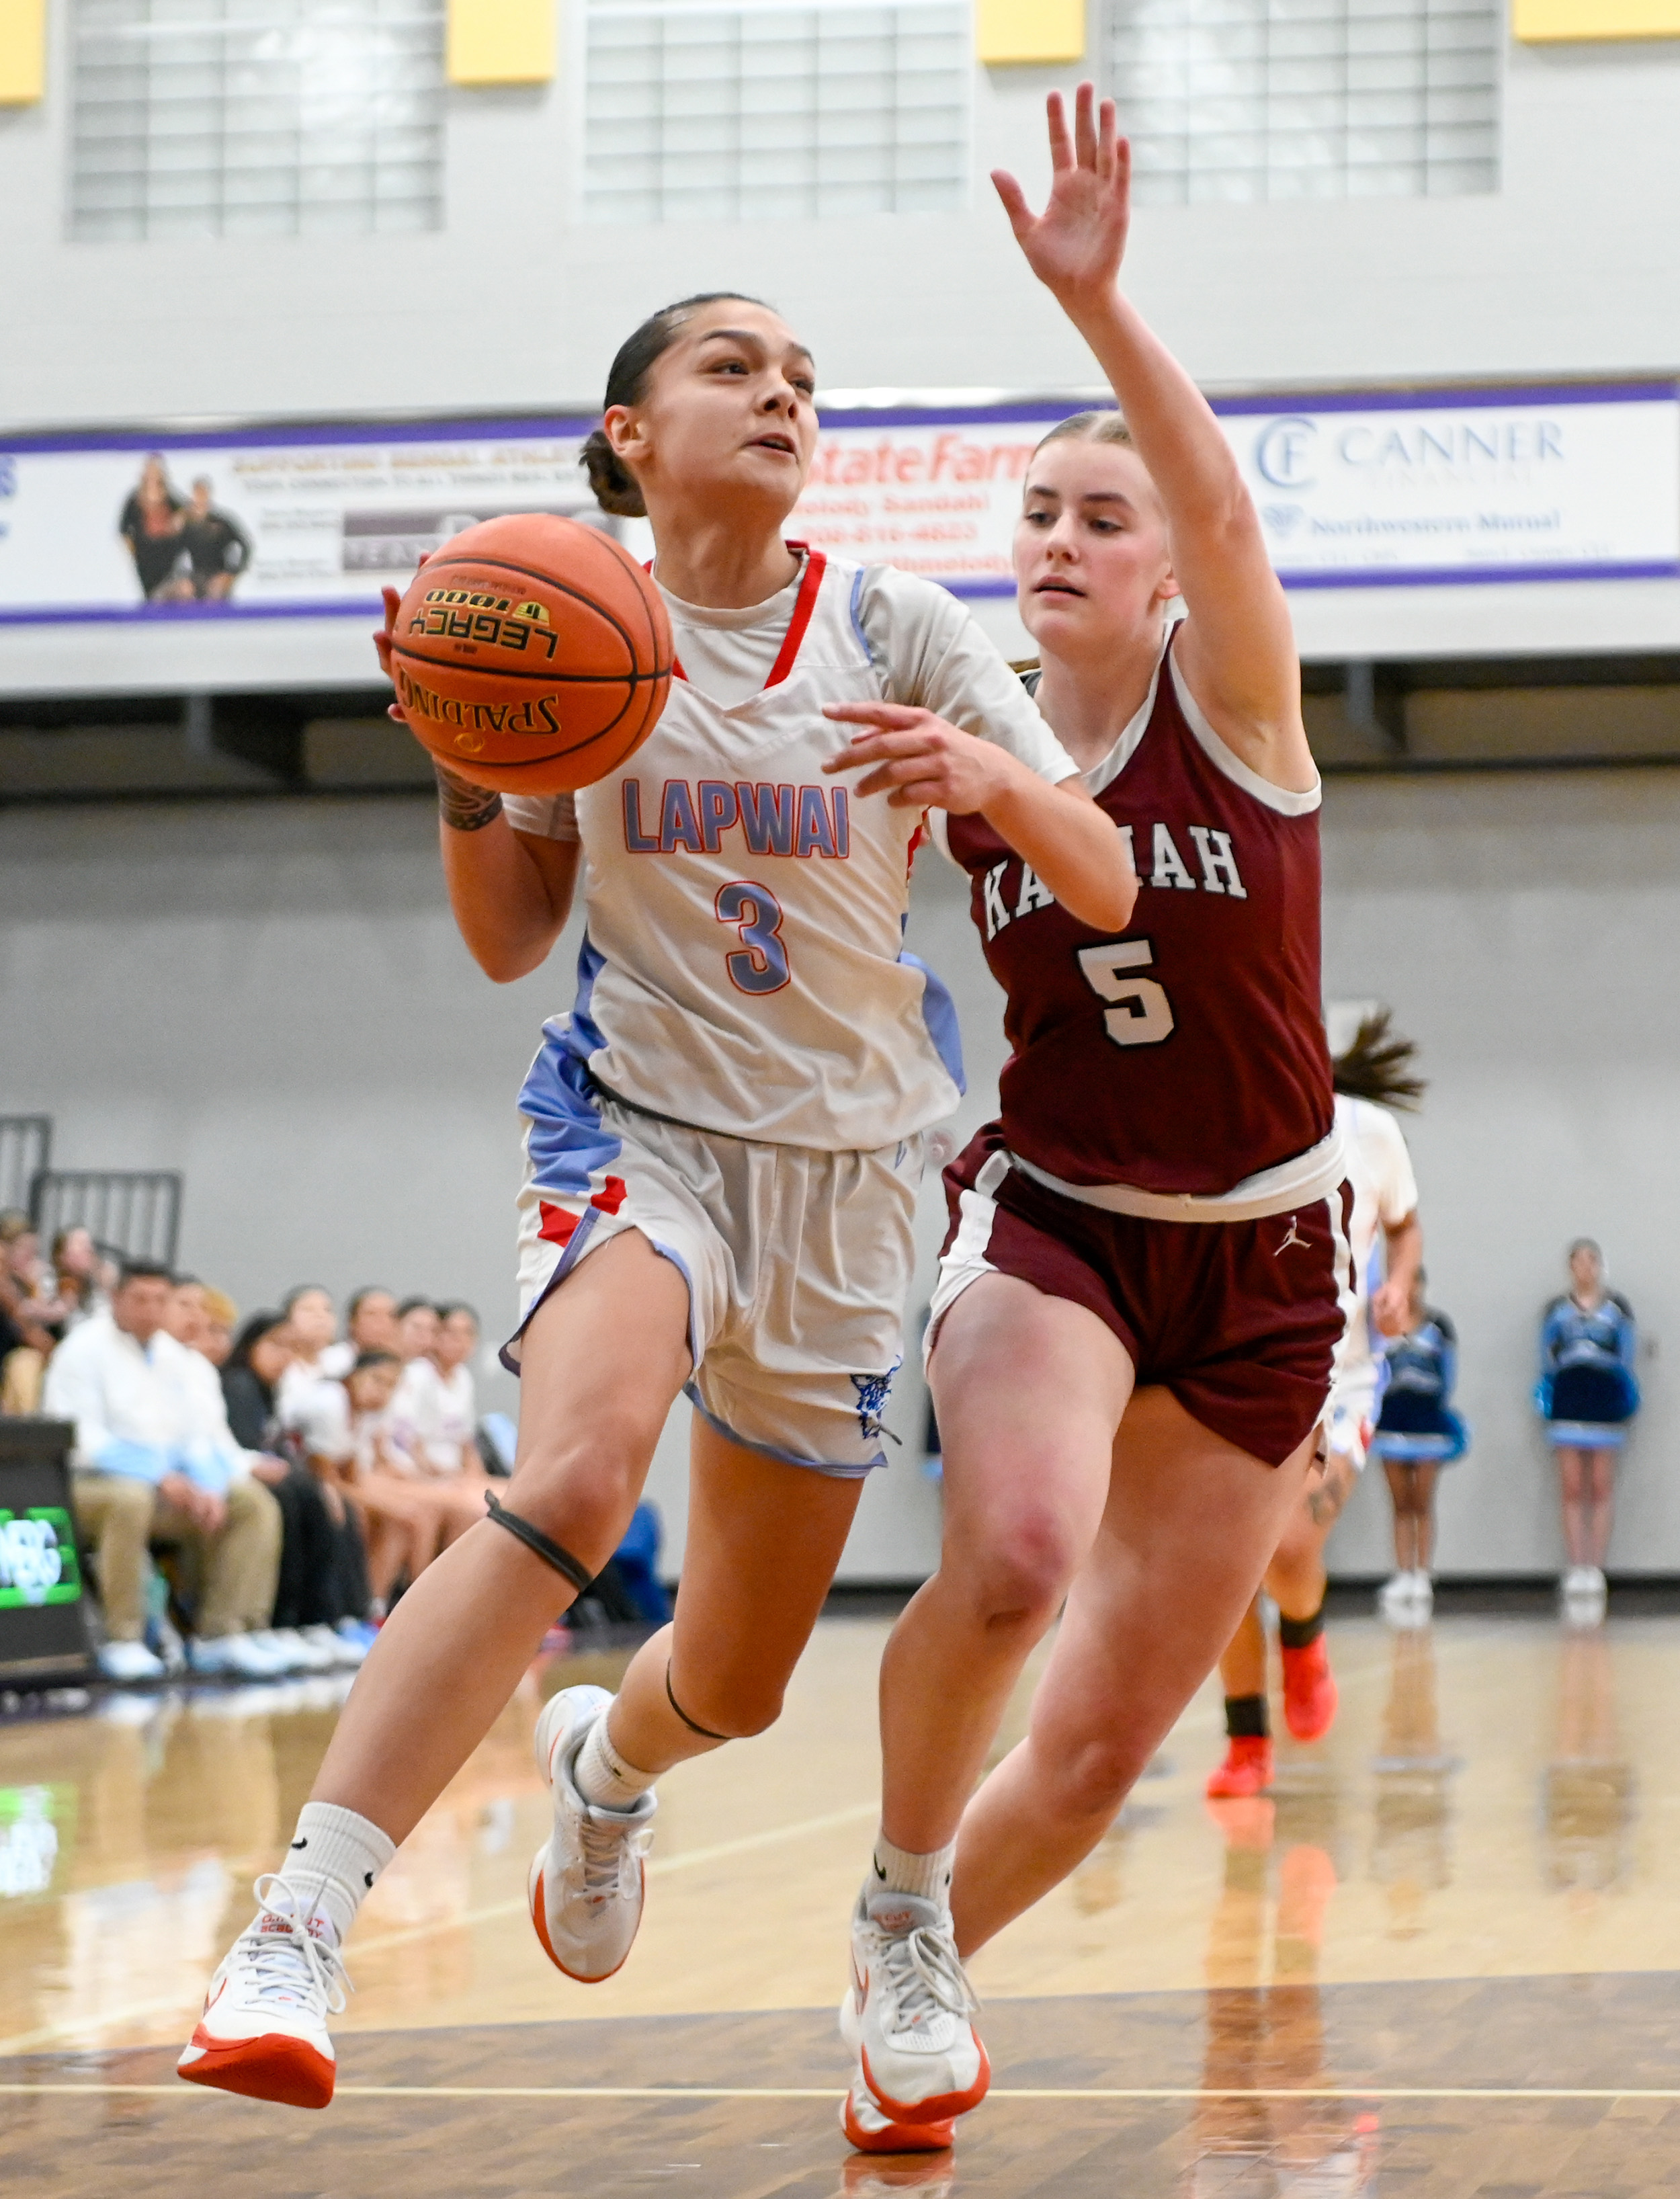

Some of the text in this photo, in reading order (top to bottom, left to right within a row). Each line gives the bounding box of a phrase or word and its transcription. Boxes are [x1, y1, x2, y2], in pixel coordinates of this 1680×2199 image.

[1338, 421, 1564, 465] CANNER
[1312, 508, 1562, 536] Northwestern Mutual
[425, 588, 511, 615] 1000
[409, 609, 558, 661] LEGACY
[622, 778, 849, 858] LAPWAI
[714, 880, 791, 995] 3
[1078, 939, 1174, 1046] 5
